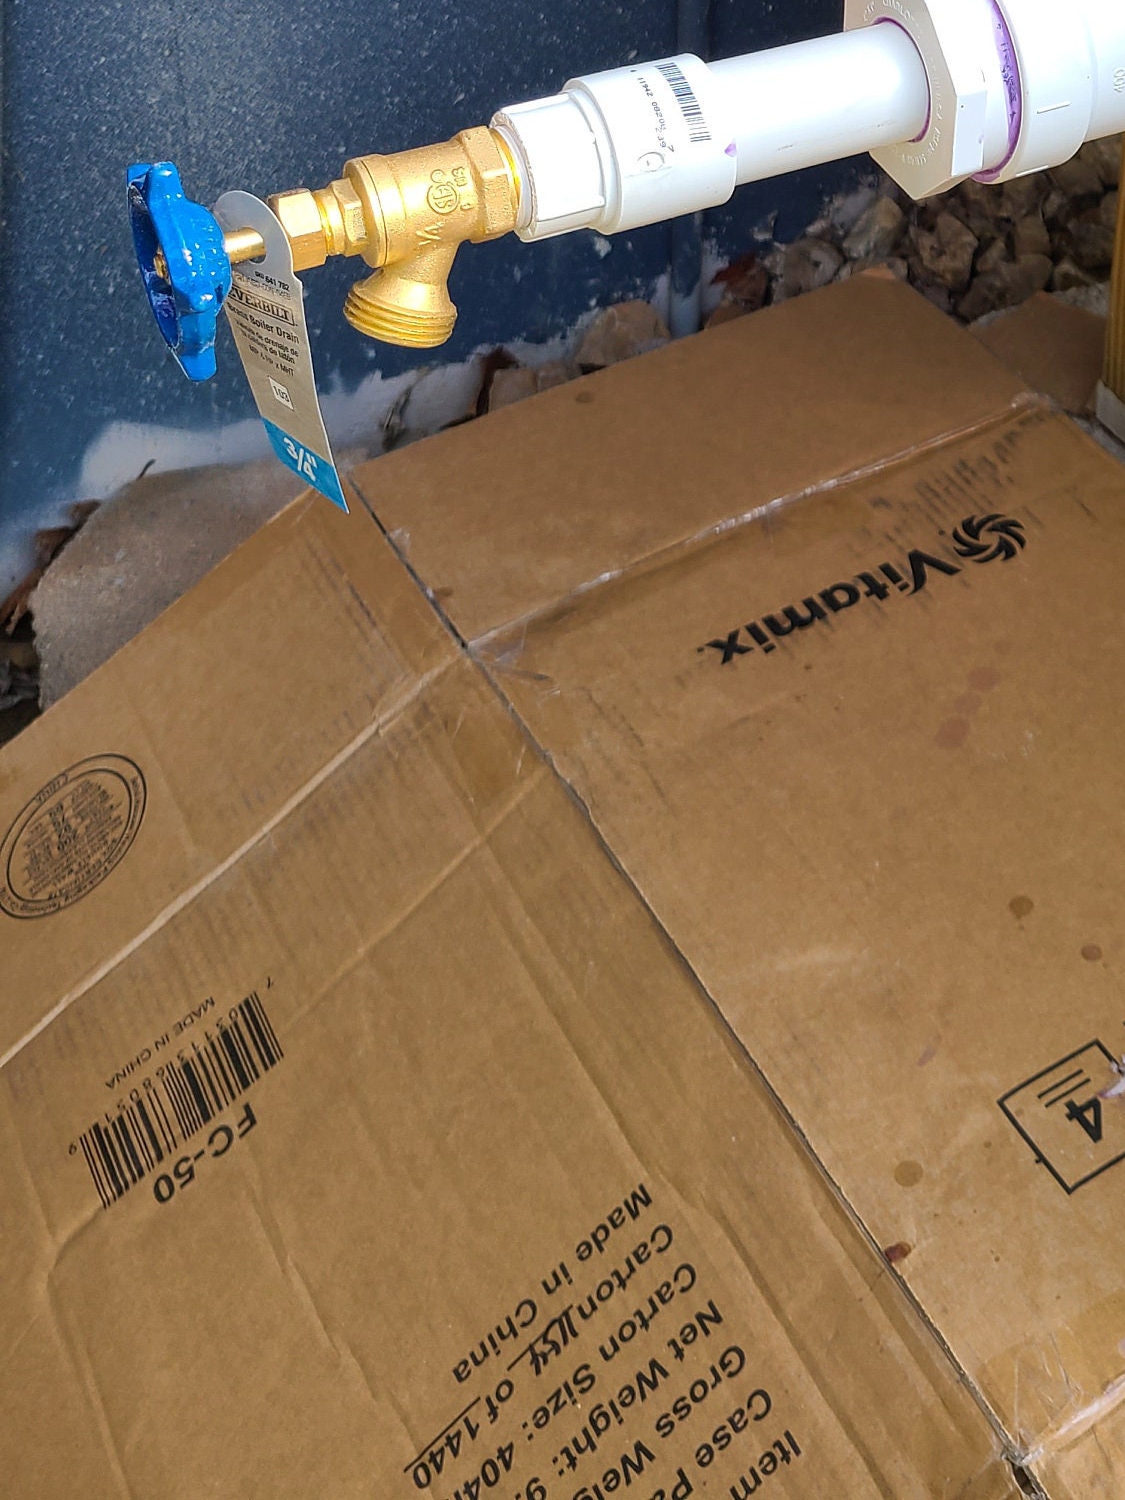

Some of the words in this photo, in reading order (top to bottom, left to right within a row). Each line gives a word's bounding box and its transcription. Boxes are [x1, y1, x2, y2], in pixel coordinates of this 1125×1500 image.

[249, 314, 274, 334] Boiler
[276, 327, 300, 345] Drain
[705, 549, 962, 666] Vitamix
[153, 1034, 170, 1052] IN
[175, 996, 216, 1035] MADE
[105, 1048, 152, 1090] CHINA
[153, 1102, 258, 1204] FC-50
[1064, 1096, 1103, 1144] 4
[576, 1183, 654, 1263] Made
[540, 1262, 574, 1297] in
[577, 1224, 674, 1322] Carton
[452, 1299, 539, 1384] China
[599, 1263, 698, 1362] Carton
[668, 1300, 724, 1363] Net
[487, 1379, 516, 1425] of
[522, 1364, 597, 1441] Size:
[552, 1357, 670, 1477] Weight:
[655, 1345, 747, 1439] Gross
[695, 1388, 773, 1468] Case
[413, 1415, 480, 1490] 1440
